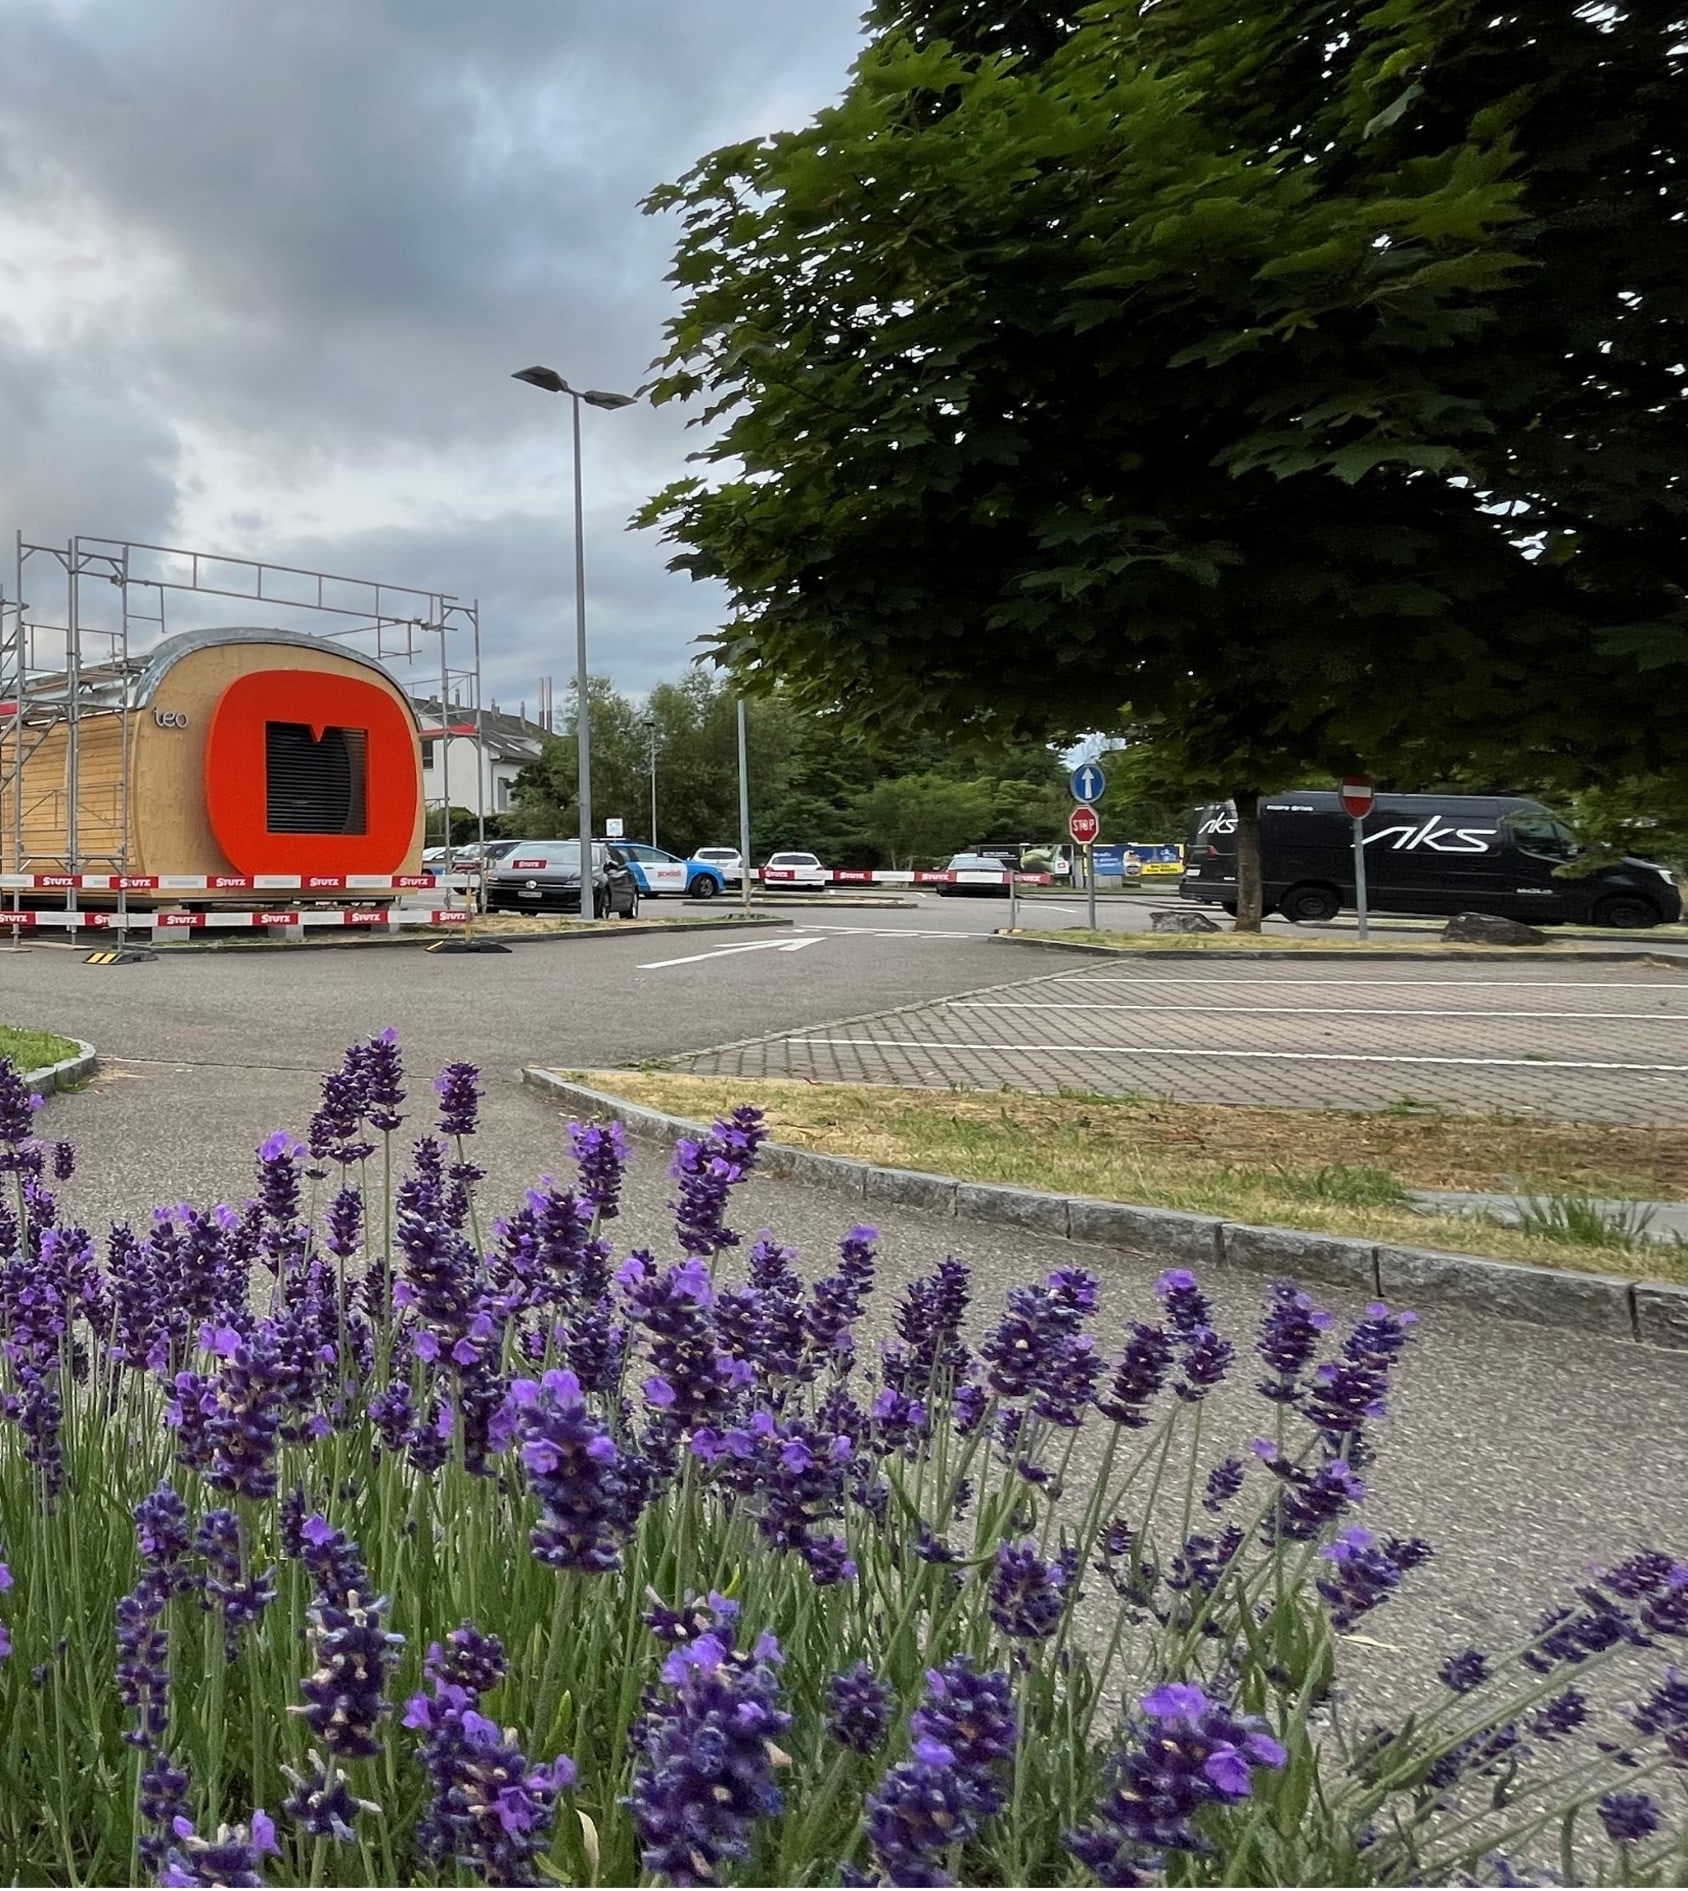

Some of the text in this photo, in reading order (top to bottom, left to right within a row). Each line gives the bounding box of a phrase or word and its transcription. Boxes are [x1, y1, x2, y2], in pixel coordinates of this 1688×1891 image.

[153, 706, 189, 728] teo
[1072, 818, 1095, 831] STOP
[43, 876, 74, 886] STUTZ
[215, 877, 247, 887] STUTZ
[309, 877, 340, 887] STUTZ
[399, 877, 429, 886] STUTZ
[166, 915, 198, 925] STUTZ
[261, 914, 292, 923] STUTZ
[351, 912, 381, 922] STUTZ
